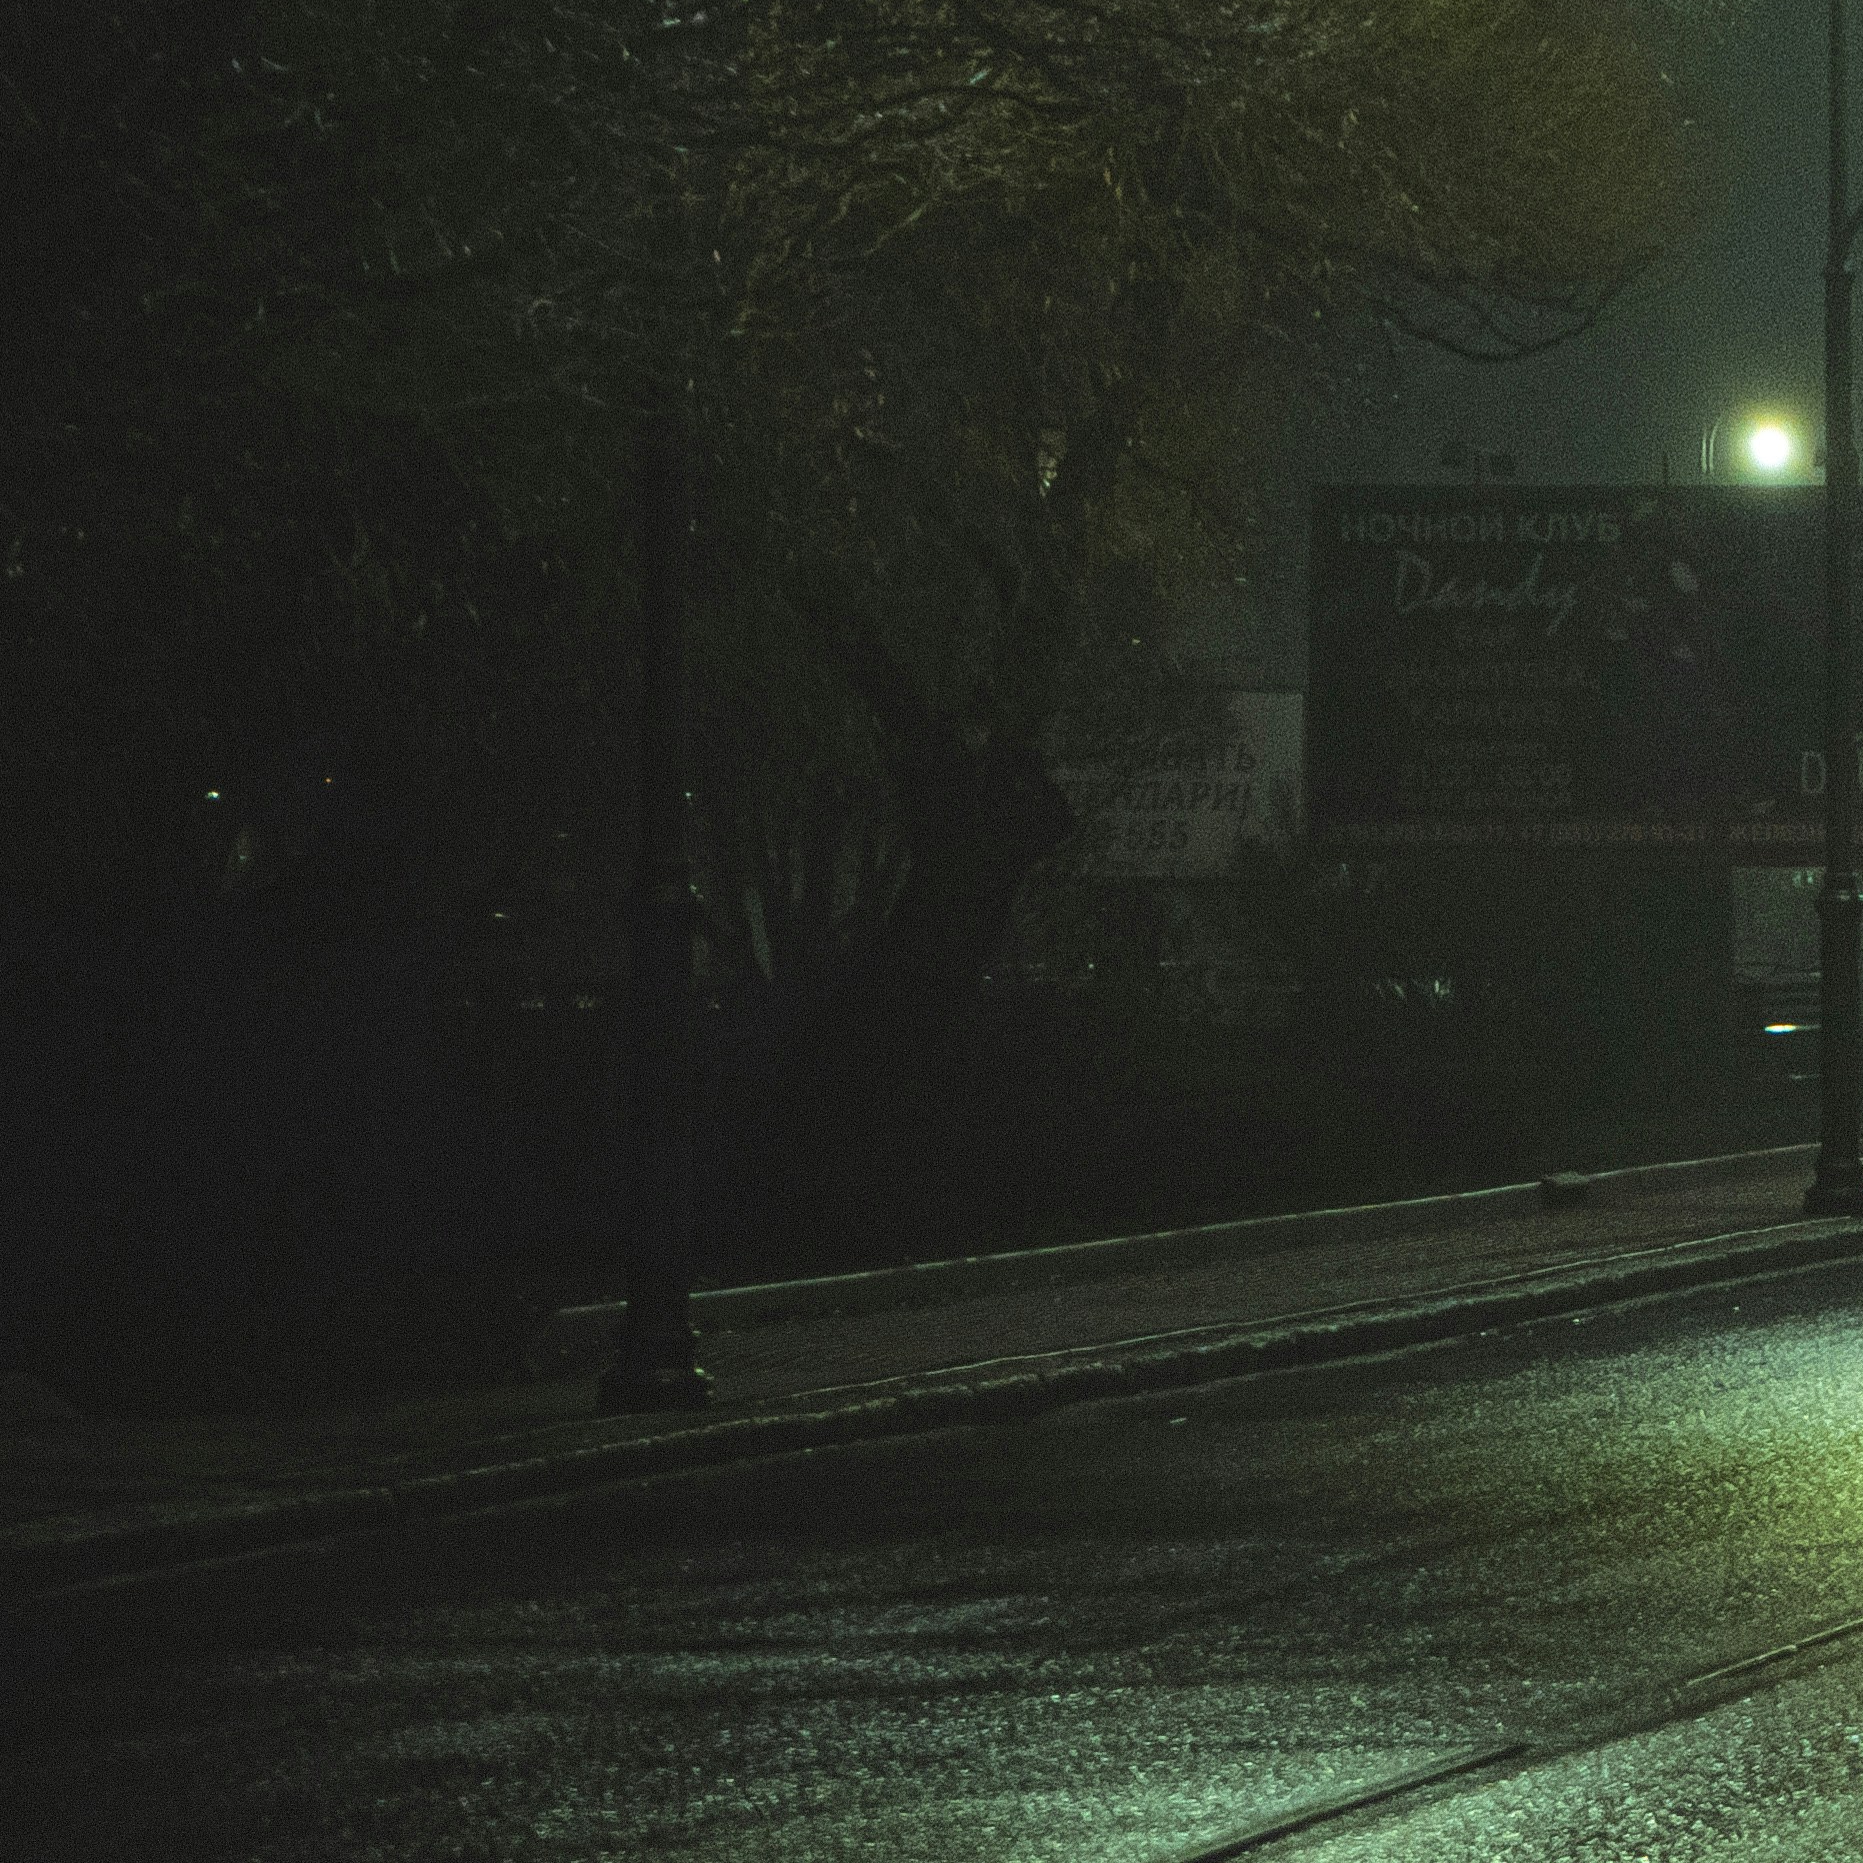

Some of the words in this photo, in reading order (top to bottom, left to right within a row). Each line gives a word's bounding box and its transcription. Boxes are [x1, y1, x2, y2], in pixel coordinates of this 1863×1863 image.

[1341, 504, 1504, 543] НОЧНОЙ
[1517, 512, 1622, 543] КЛУБ
[1395, 549, 1579, 636] Dandy
